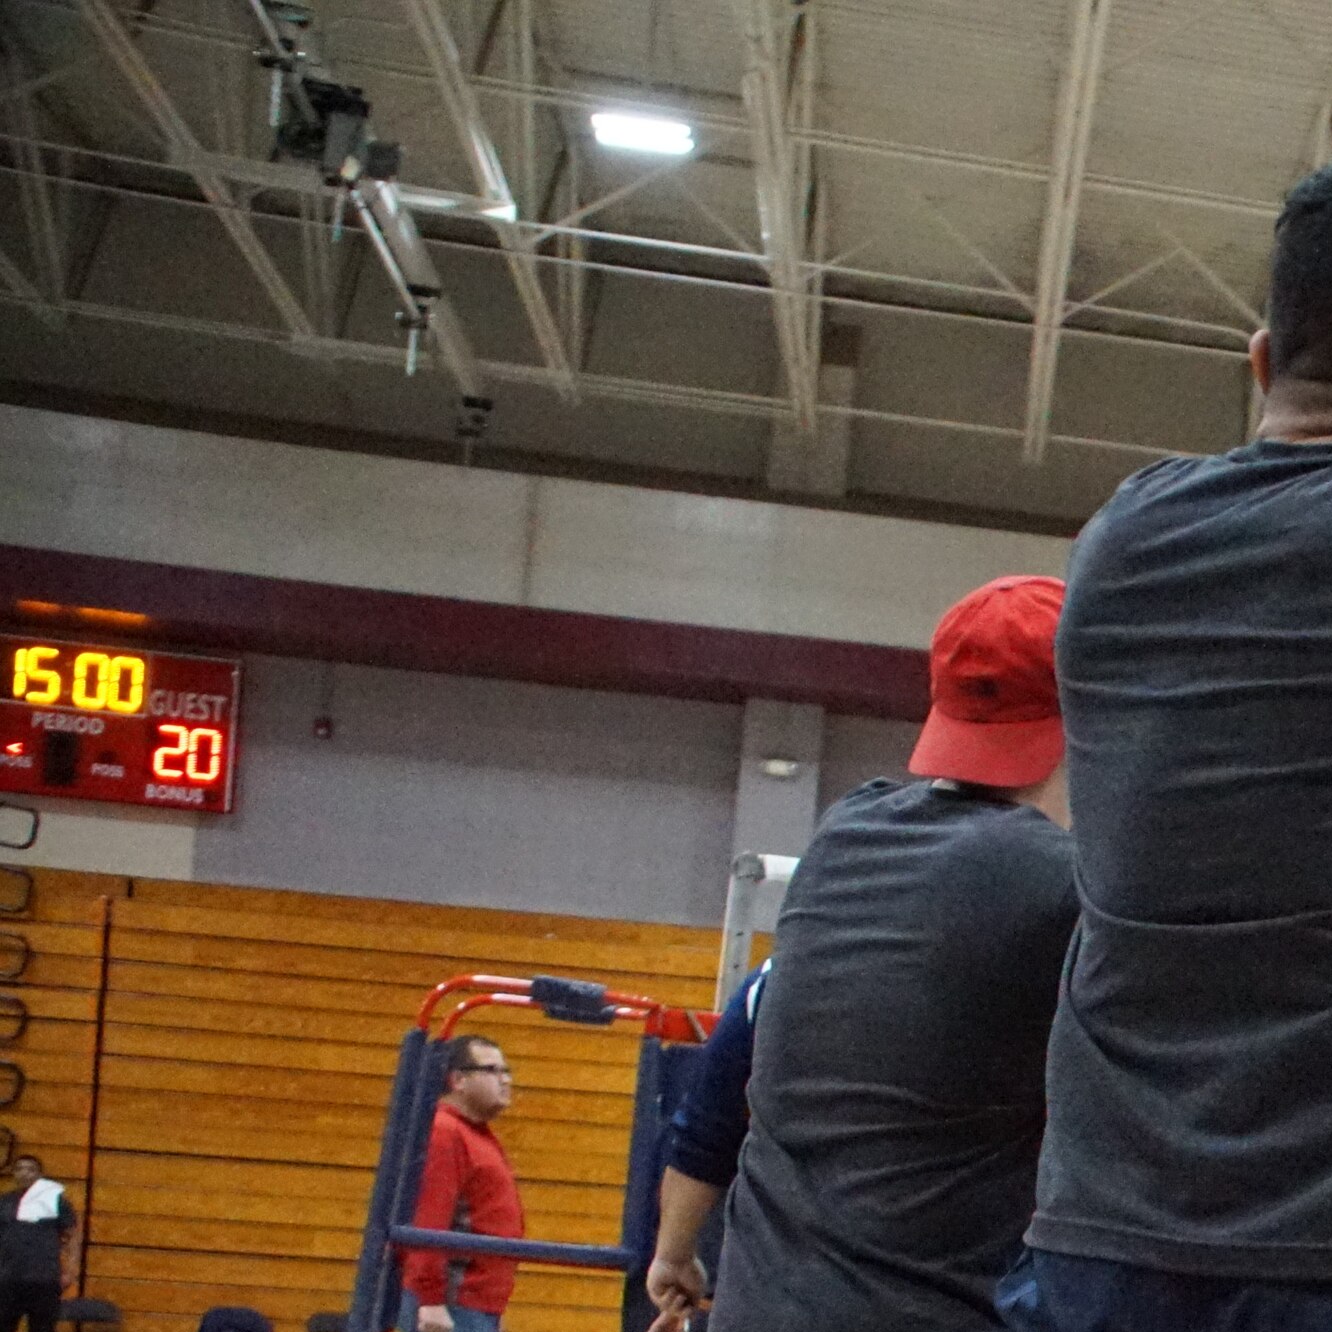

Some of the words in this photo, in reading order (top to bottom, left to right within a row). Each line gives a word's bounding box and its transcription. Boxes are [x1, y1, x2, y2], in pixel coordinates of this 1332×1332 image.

[150, 688, 228, 721] GUEST
[31, 710, 105, 734] PERIOD
[152, 723, 223, 781] 20
[145, 783, 204, 804] BONUS
